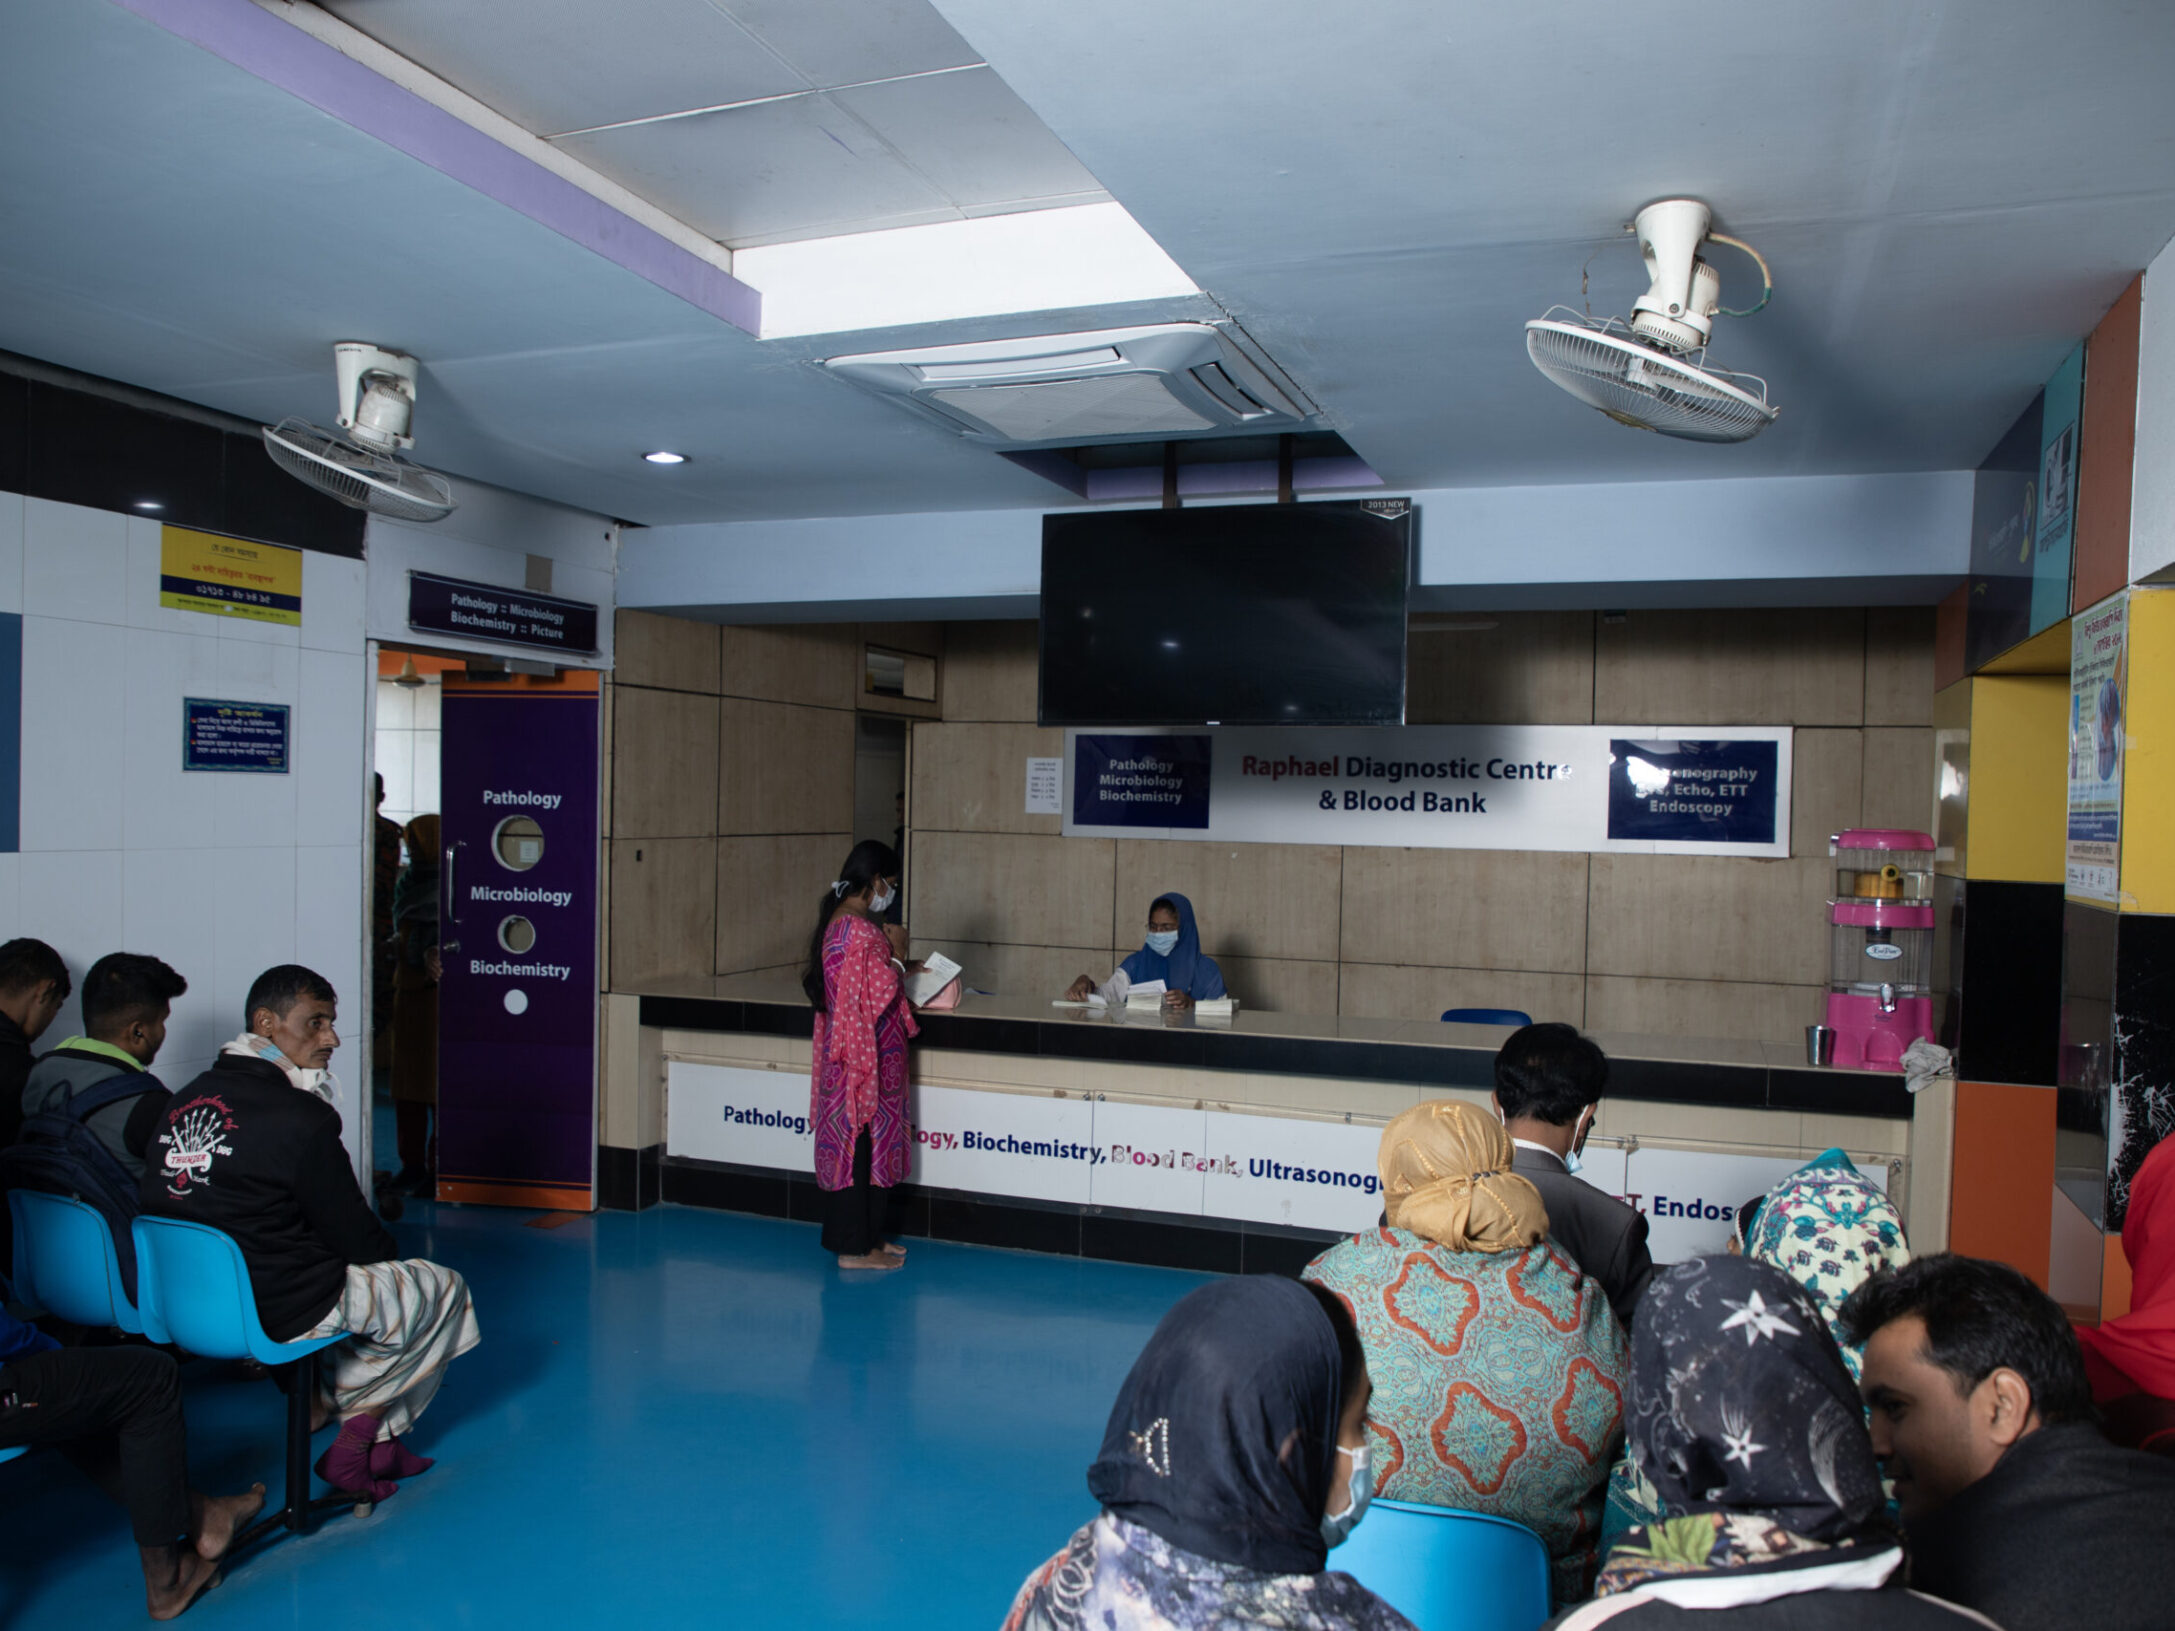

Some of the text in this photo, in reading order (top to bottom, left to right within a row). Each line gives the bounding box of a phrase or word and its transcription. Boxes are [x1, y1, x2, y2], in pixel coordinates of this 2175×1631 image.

[1368, 500, 1405, 509] 2013 NEW
[451, 593, 498, 614] Pathology
[509, 603, 565, 625] Microbiology
[450, 611, 516, 635] Biochemistry
[531, 625, 564, 640] Picture
[1109, 759, 1174, 774] Pathology
[1241, 755, 1339, 781] Raphael
[1346, 756, 1480, 783] Diagnostic
[1099, 774, 1184, 790] Microbiology
[1674, 784, 1716, 798] Echo,
[1719, 784, 1748, 797] ETT
[482, 789, 562, 810] Pathology
[1099, 789, 1183, 805] Biochemistry
[1318, 790, 1487, 813] & Blood Bank
[1649, 800, 1733, 817] Endoscopy
[470, 885, 573, 907] Microbiology
[470, 960, 571, 981] Biochemistry
[171, 1154, 207, 1165] THUNDER
[963, 1131, 1107, 1165] Biochemistry,
[1111, 1144, 1175, 1169] Blood
[1654, 1196, 1736, 1222] Endos
